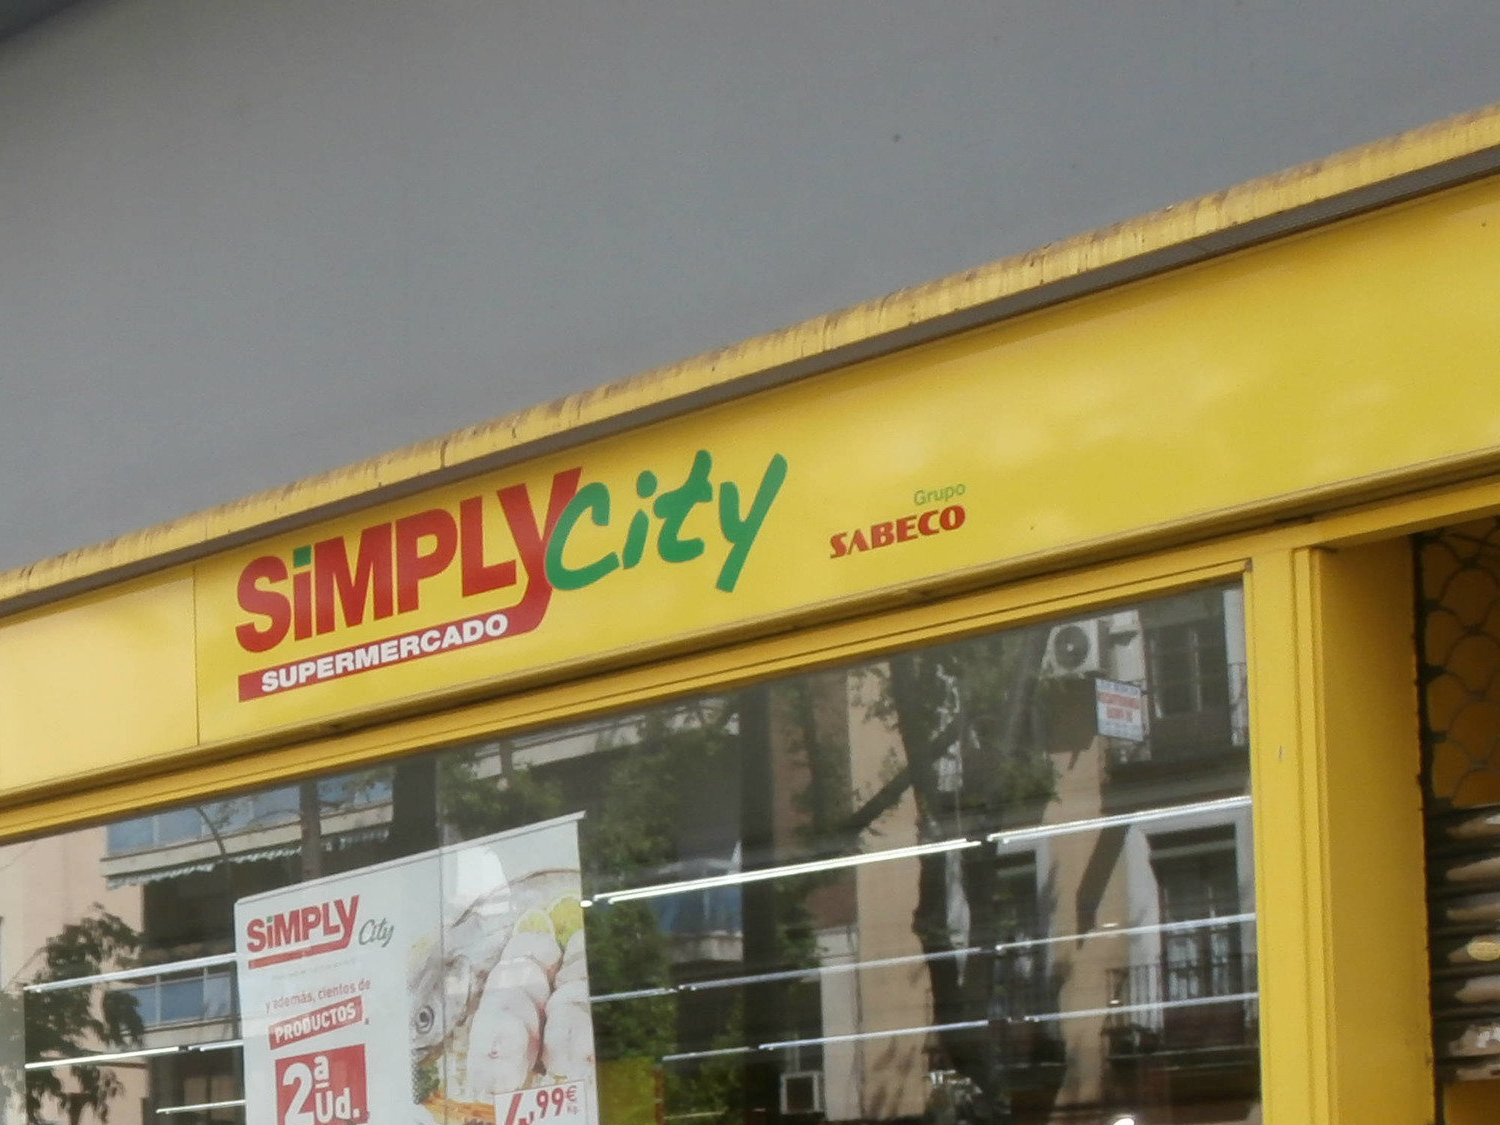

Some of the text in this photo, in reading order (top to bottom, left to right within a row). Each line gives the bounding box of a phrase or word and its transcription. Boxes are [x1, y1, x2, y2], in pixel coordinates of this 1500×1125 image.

[913, 483, 966, 506] Grupo
[544, 450, 788, 593] City
[829, 505, 966, 558] SABECO
[261, 613, 508, 693] SUPERMERCADO
[358, 918, 394, 948] City
[318, 981, 356, 1000] cientos
[358, 978, 371, 992] de
[274, 1002, 357, 1044] PRODUCTOS
